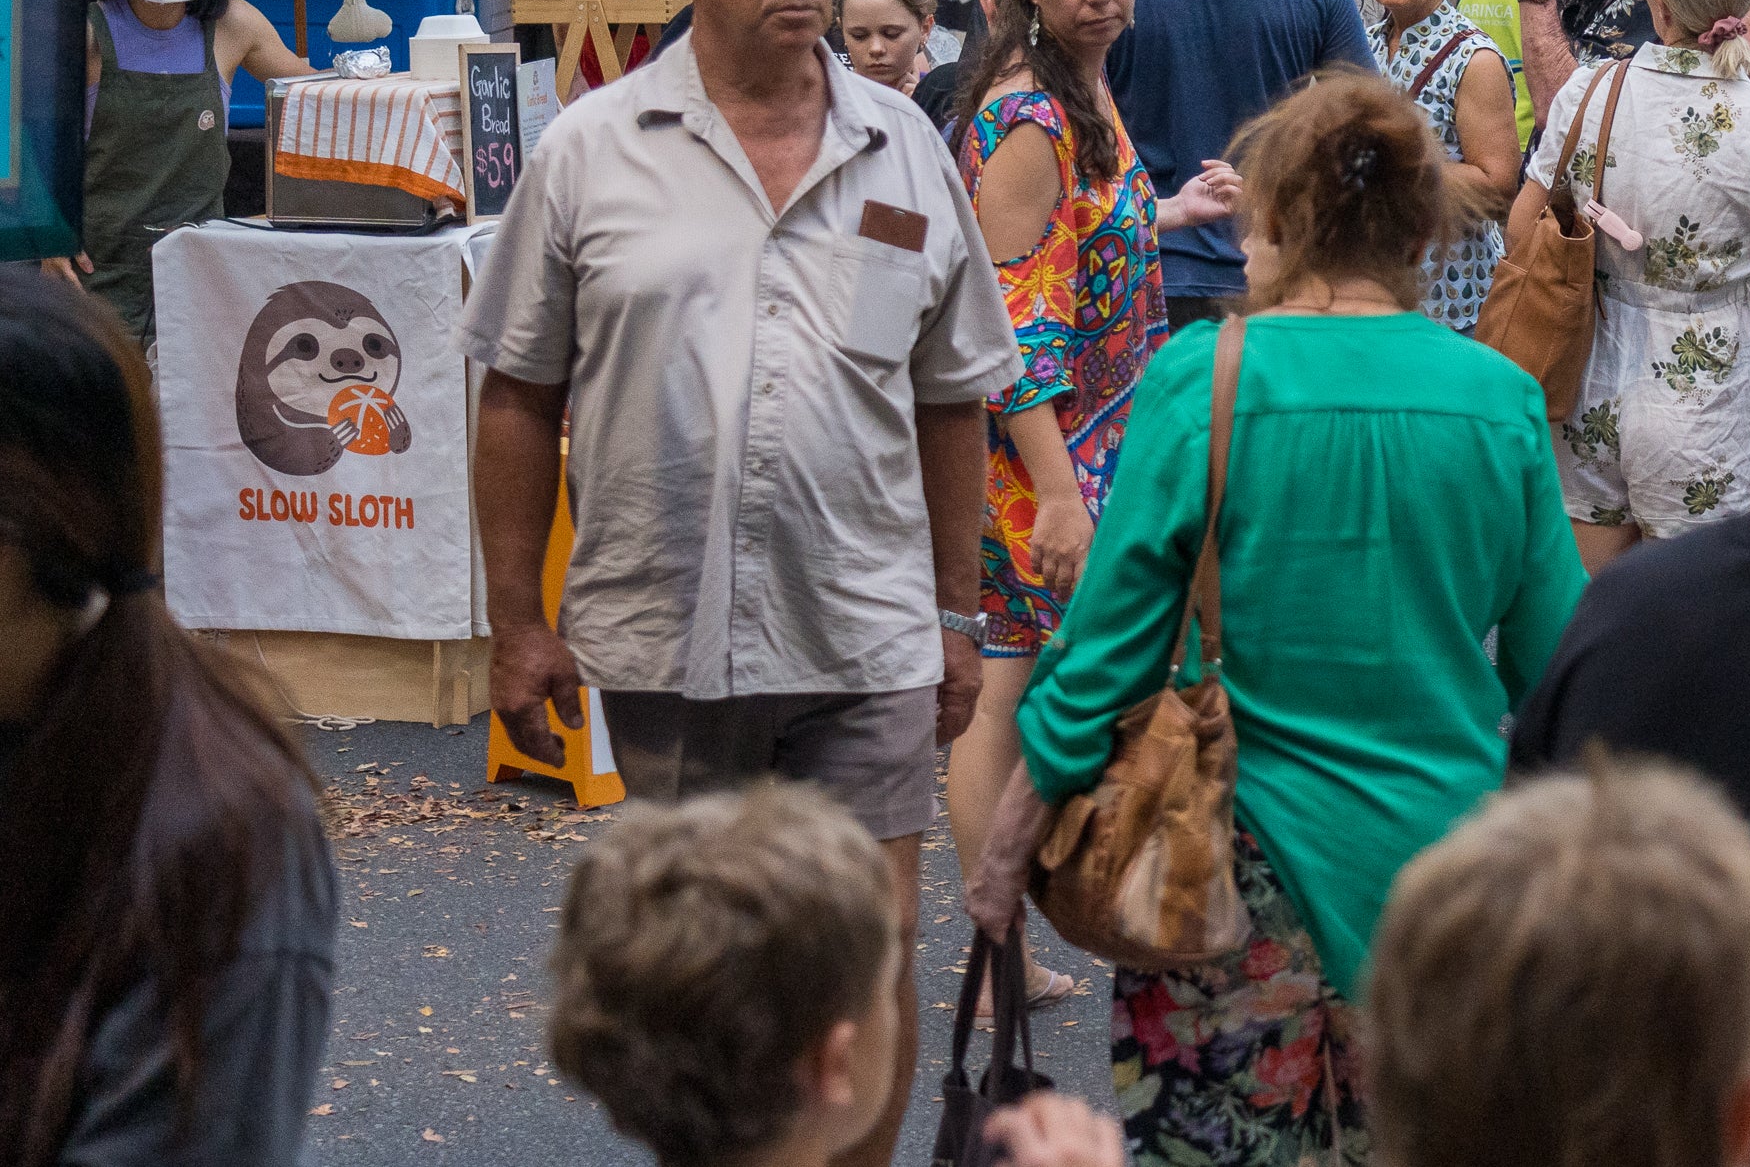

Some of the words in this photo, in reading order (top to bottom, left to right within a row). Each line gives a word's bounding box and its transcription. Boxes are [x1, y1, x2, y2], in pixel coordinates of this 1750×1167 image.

[1460, 3, 1514, 19] ARINGA
[470, 65, 511, 100] Garlic
[481, 103, 511, 135] Bread
[239, 488, 318, 523] SLOW
[328, 493, 414, 529] SLOTH
